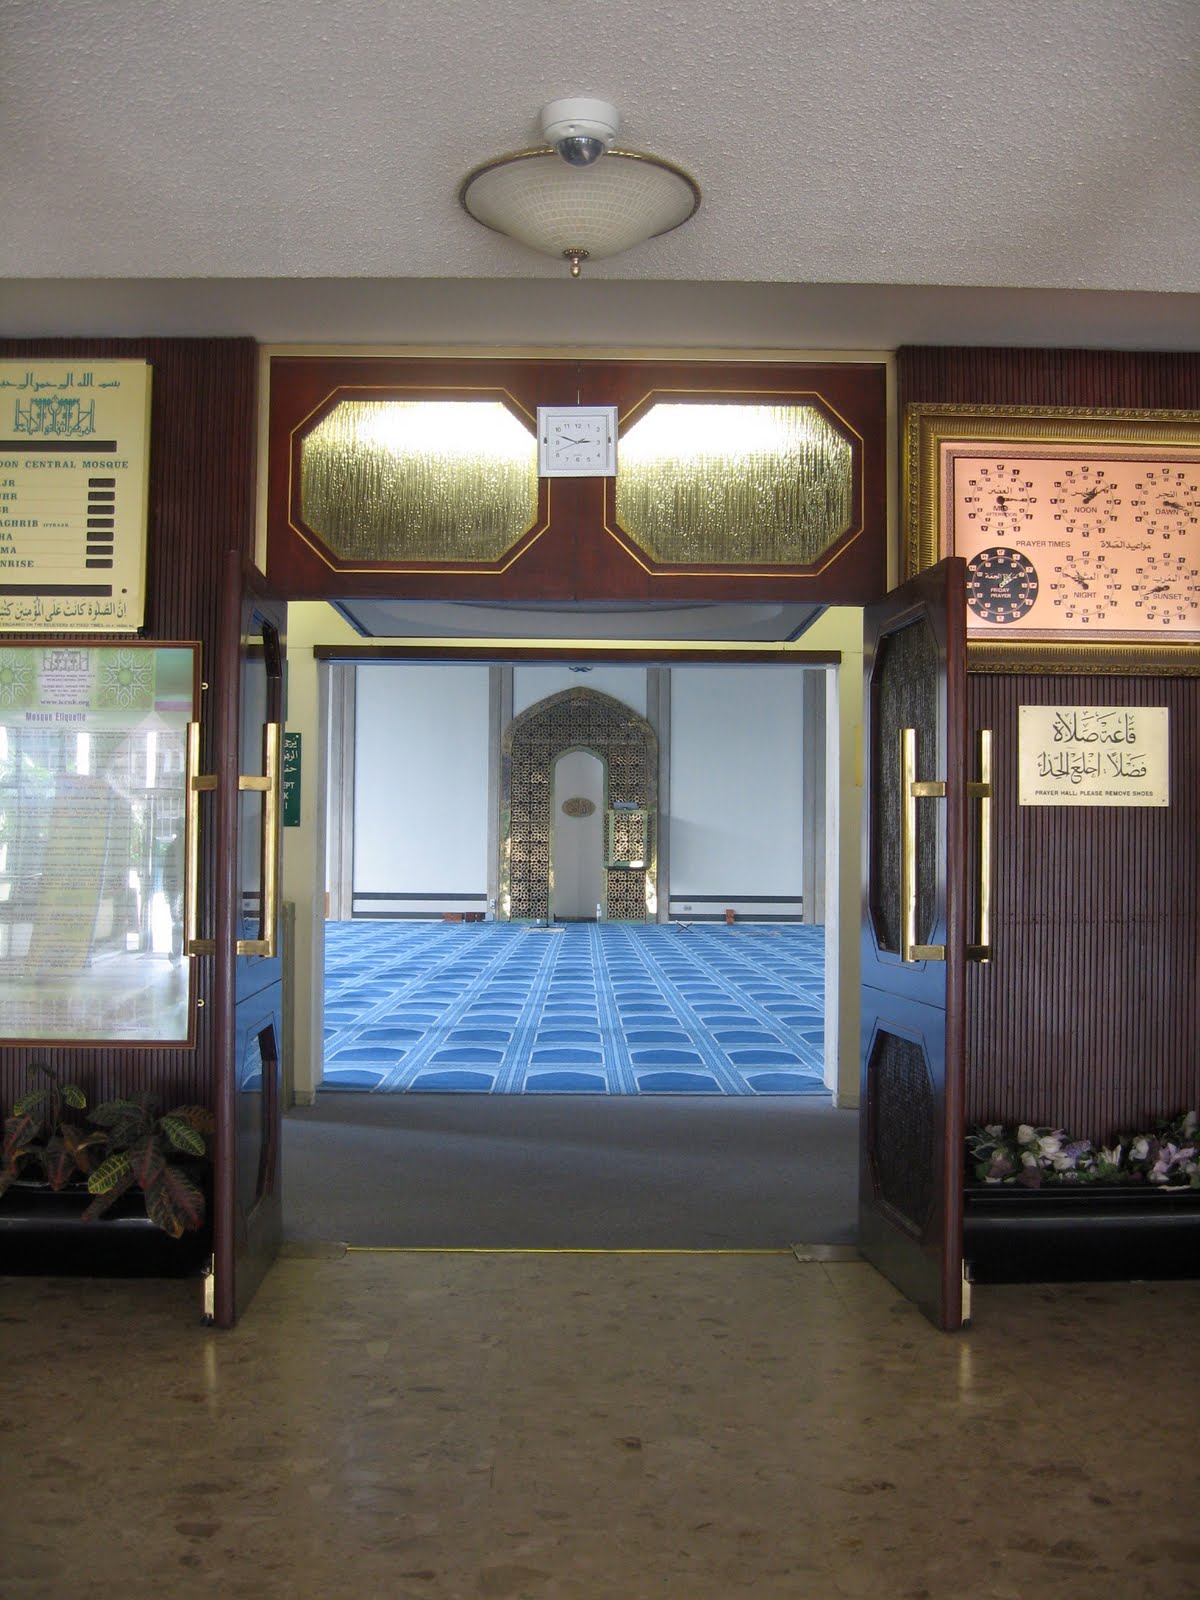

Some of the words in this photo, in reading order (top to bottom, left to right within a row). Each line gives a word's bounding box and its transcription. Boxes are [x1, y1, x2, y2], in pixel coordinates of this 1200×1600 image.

[77, 373, 94, 388] الله
[82, 461, 129, 469] MOSQUE
[26, 712, 53, 723] Mosque
[56, 712, 87, 723] Etiquette
